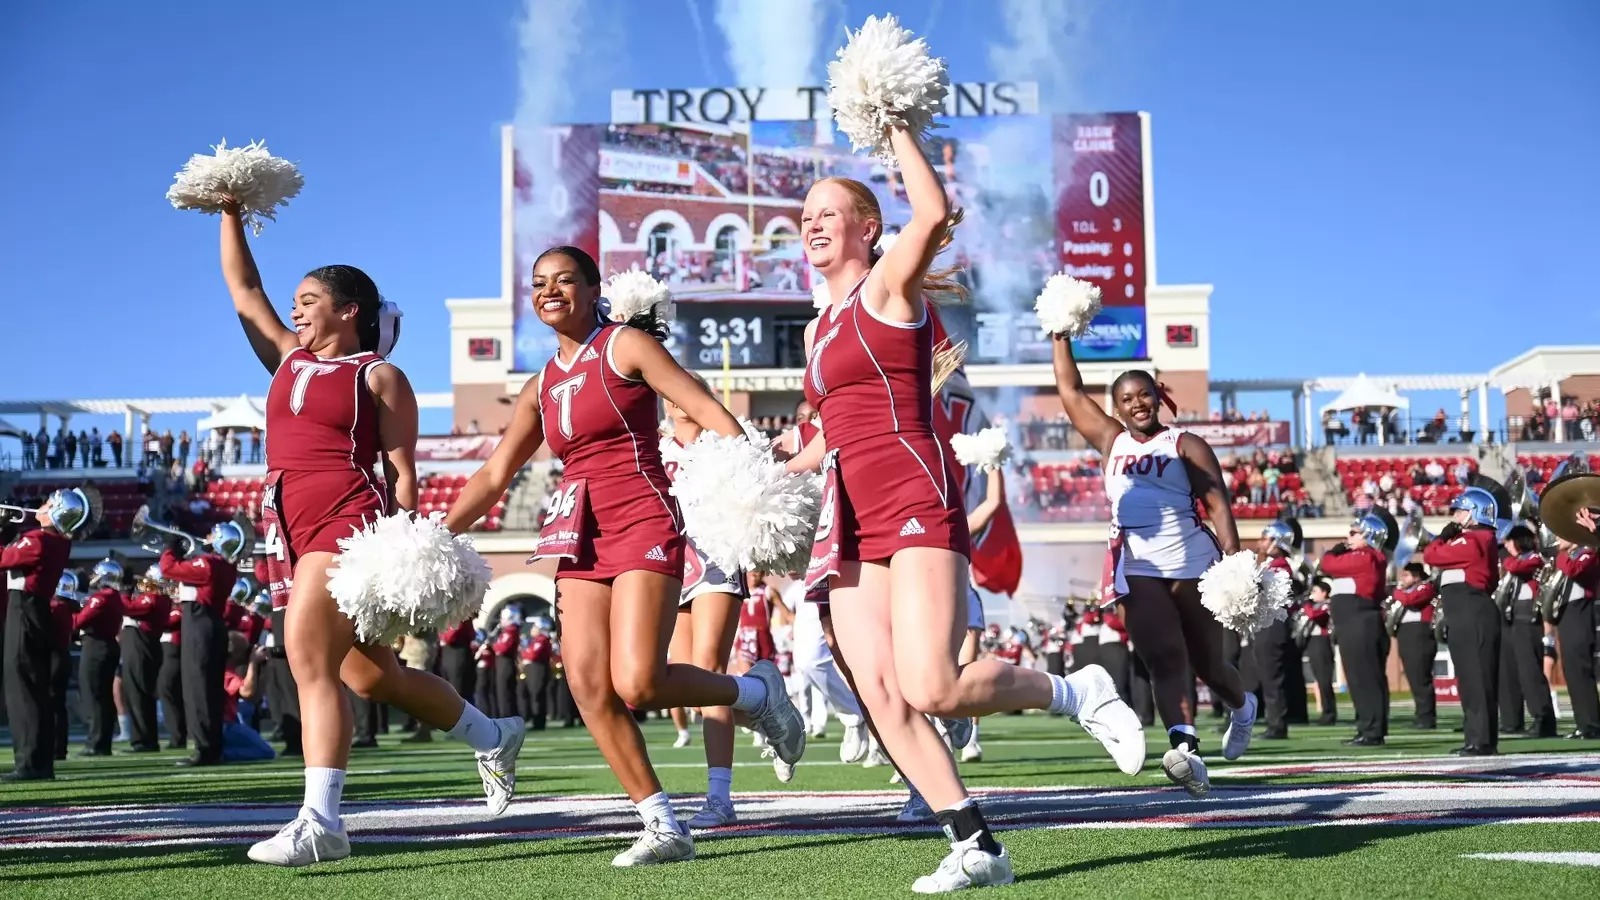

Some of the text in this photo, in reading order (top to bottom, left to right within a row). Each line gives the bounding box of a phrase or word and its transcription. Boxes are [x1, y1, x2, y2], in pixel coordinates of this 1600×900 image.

[632, 87, 767, 123] TROY
[1089, 171, 1109, 206] 0
[1112, 217, 1122, 232] 3
[1063, 240, 1133, 257] Passing: 0
[1124, 263, 1134, 277] 0
[1125, 284, 1135, 298] 0
[700, 317, 763, 346] 3:31
[740, 347, 750, 364] 1
[290, 359, 341, 416] T
[549, 372, 587, 441] T
[1112, 453, 1173, 478] TROY
[543, 483, 578, 527] 94
[900, 527, 926, 537] adidas
[644, 553, 668, 562] adidas
